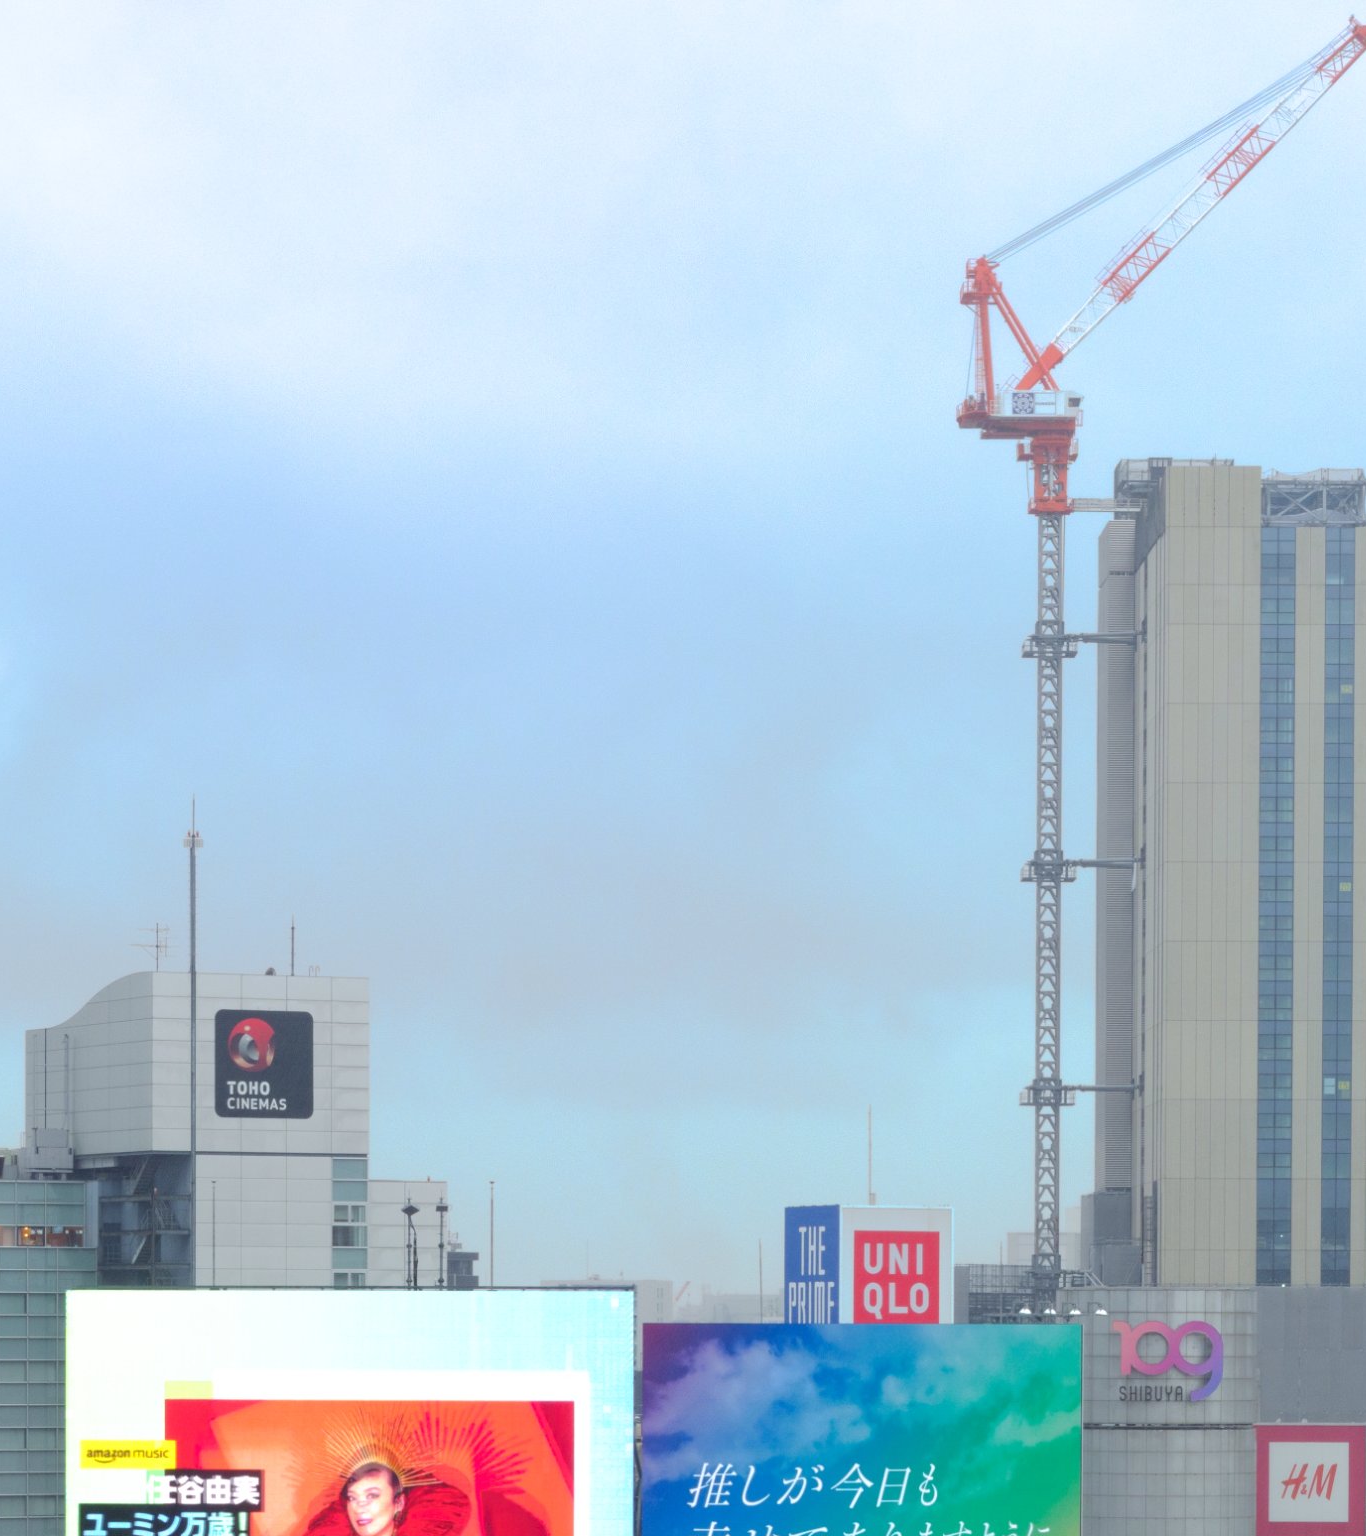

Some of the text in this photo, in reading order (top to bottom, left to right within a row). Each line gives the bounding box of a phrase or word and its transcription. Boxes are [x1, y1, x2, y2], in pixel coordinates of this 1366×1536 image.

[227, 1081, 271, 1096] TOHO
[227, 1097, 287, 1112] CINEMAS
[799, 1225, 826, 1276] THE
[863, 1243, 925, 1274] UNI
[788, 1281, 836, 1324] PRIME
[862, 1282, 930, 1321] QLO
[1113, 1320, 1225, 1401] 109
[1119, 1385, 1184, 1403] SHIBUYA
[86, 1447, 169, 1463] amazon music
[686, 1462, 938, 1509] 推しが今日も
[1282, 1464, 1338, 1501] H&M
